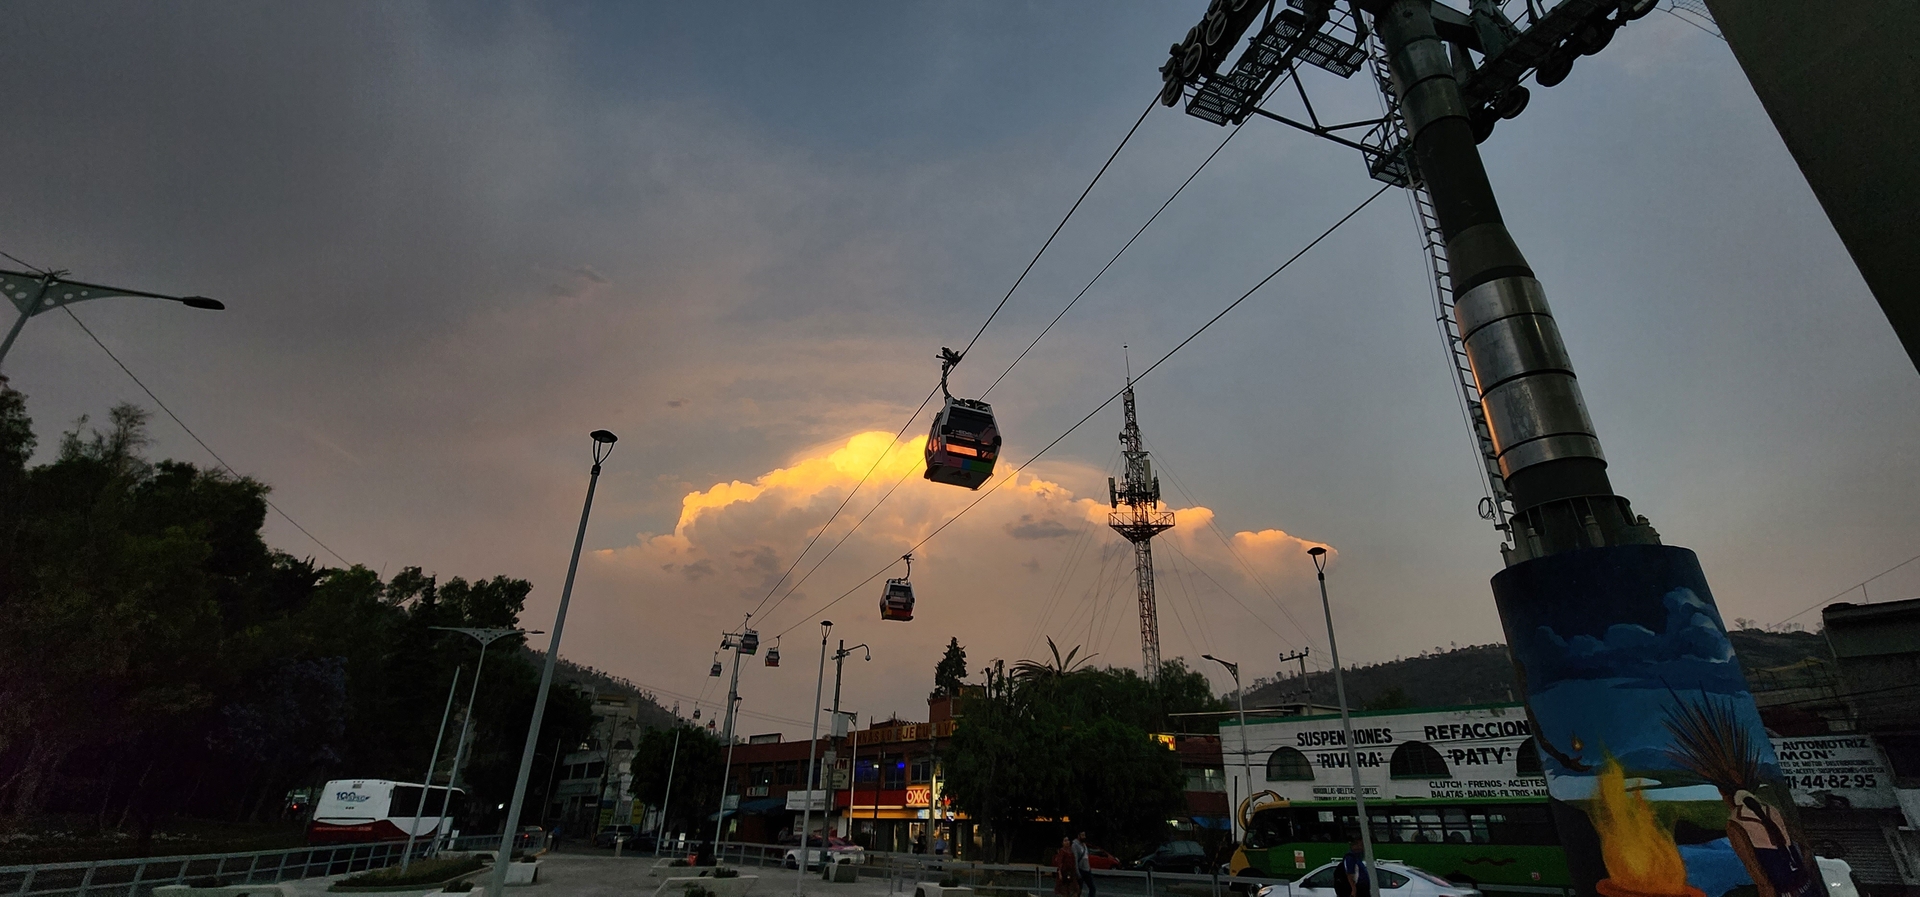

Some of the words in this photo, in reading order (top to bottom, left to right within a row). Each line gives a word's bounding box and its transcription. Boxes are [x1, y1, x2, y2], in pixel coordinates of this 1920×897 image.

[1297, 728, 1393, 746] SUSPENIONES
[1783, 738, 1869, 750] AUTOMOTRIZ
[1508, 779, 1546, 787] ACEITES
[906, 789, 931, 803] OXXO
